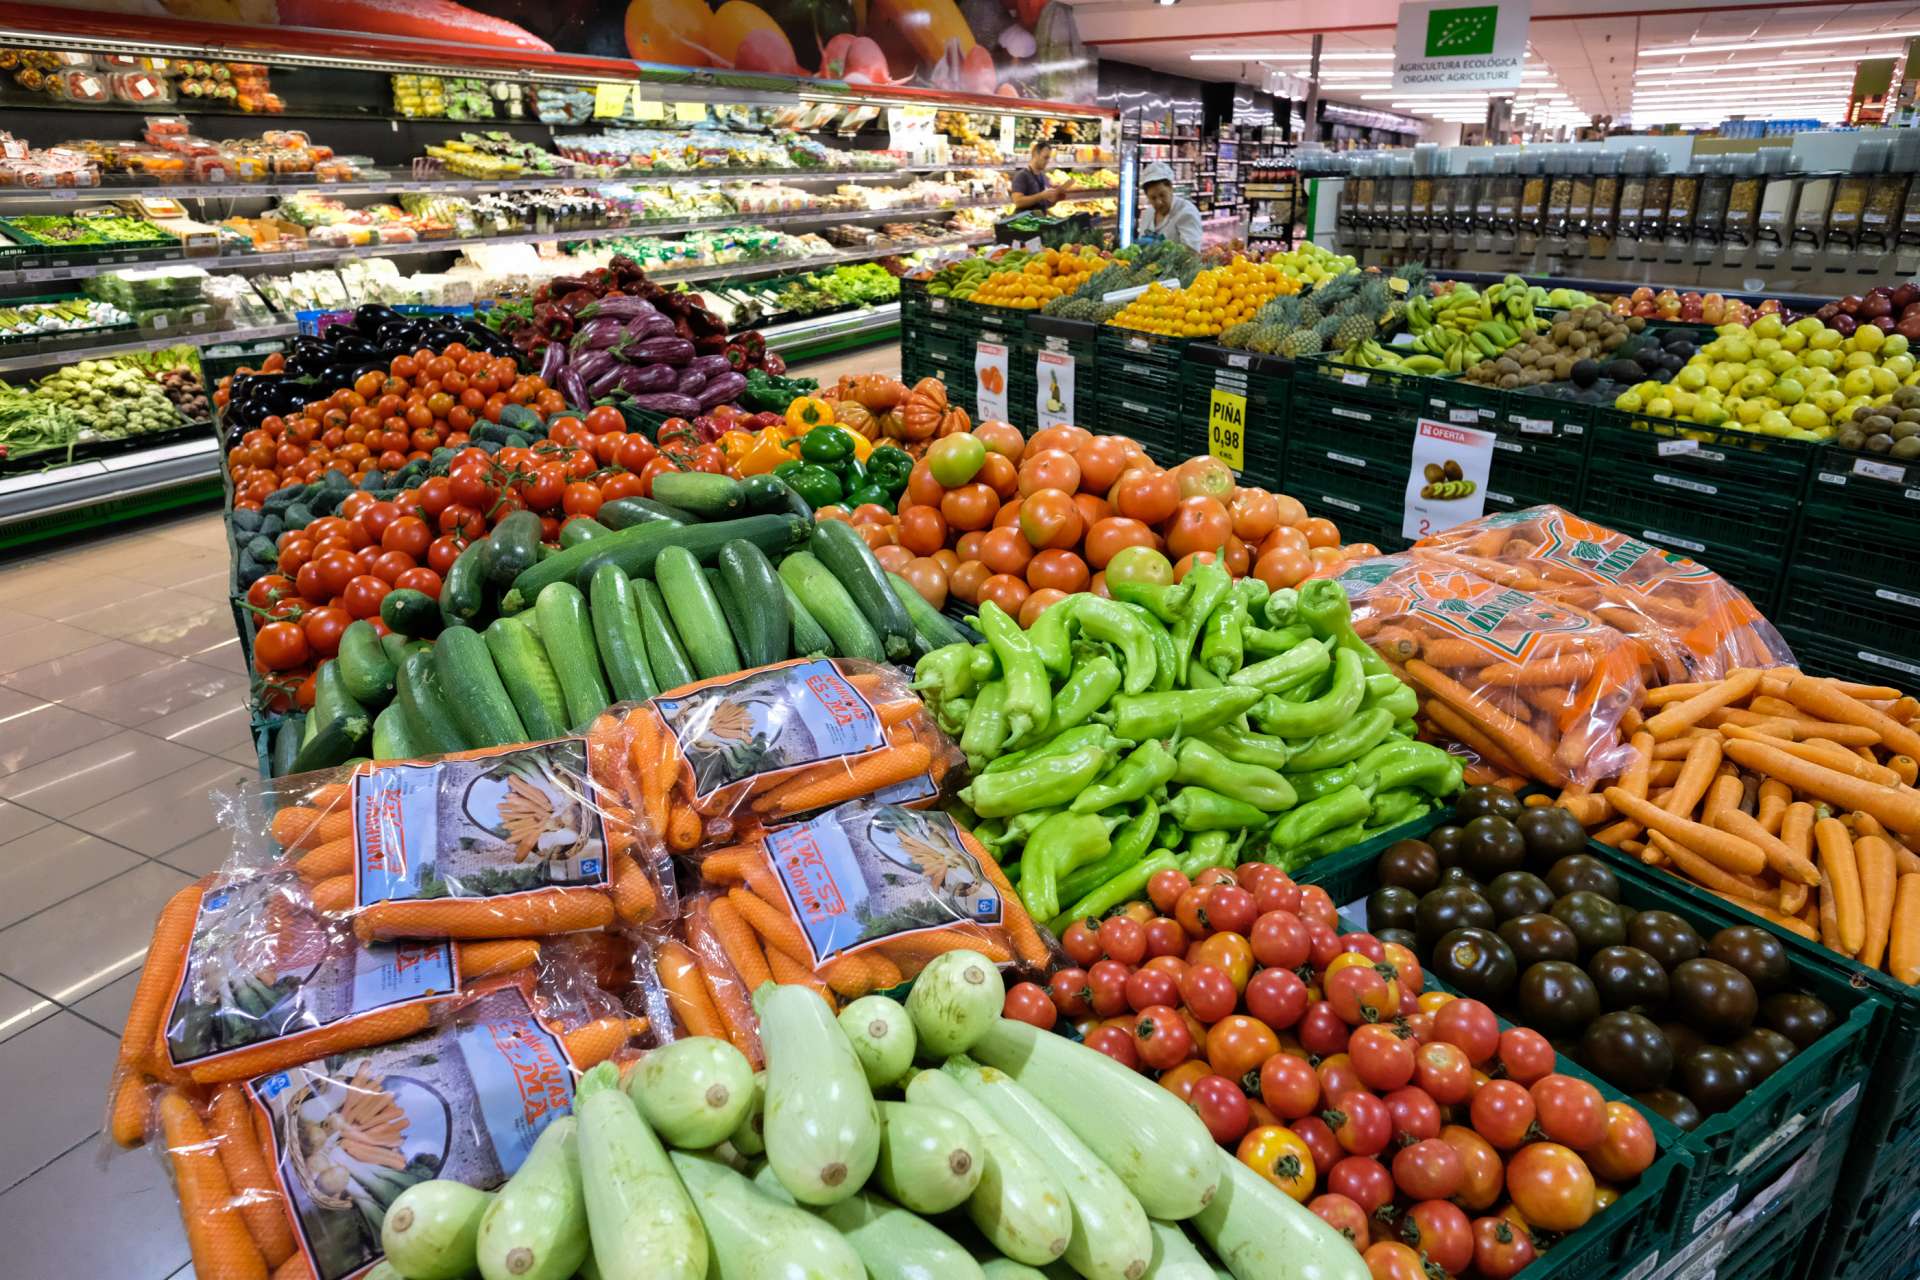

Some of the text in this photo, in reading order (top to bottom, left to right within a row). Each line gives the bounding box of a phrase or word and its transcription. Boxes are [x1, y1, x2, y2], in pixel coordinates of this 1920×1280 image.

[1398, 57, 1518, 72] AGRICULTURA ECOLÓGICA
[1402, 71, 1510, 84] ORGANIC AGRICULTURE
[1213, 402, 1242, 426] PIÑA
[1213, 426, 1240, 449] 0,98
[1432, 426, 1465, 442] OFERTA
